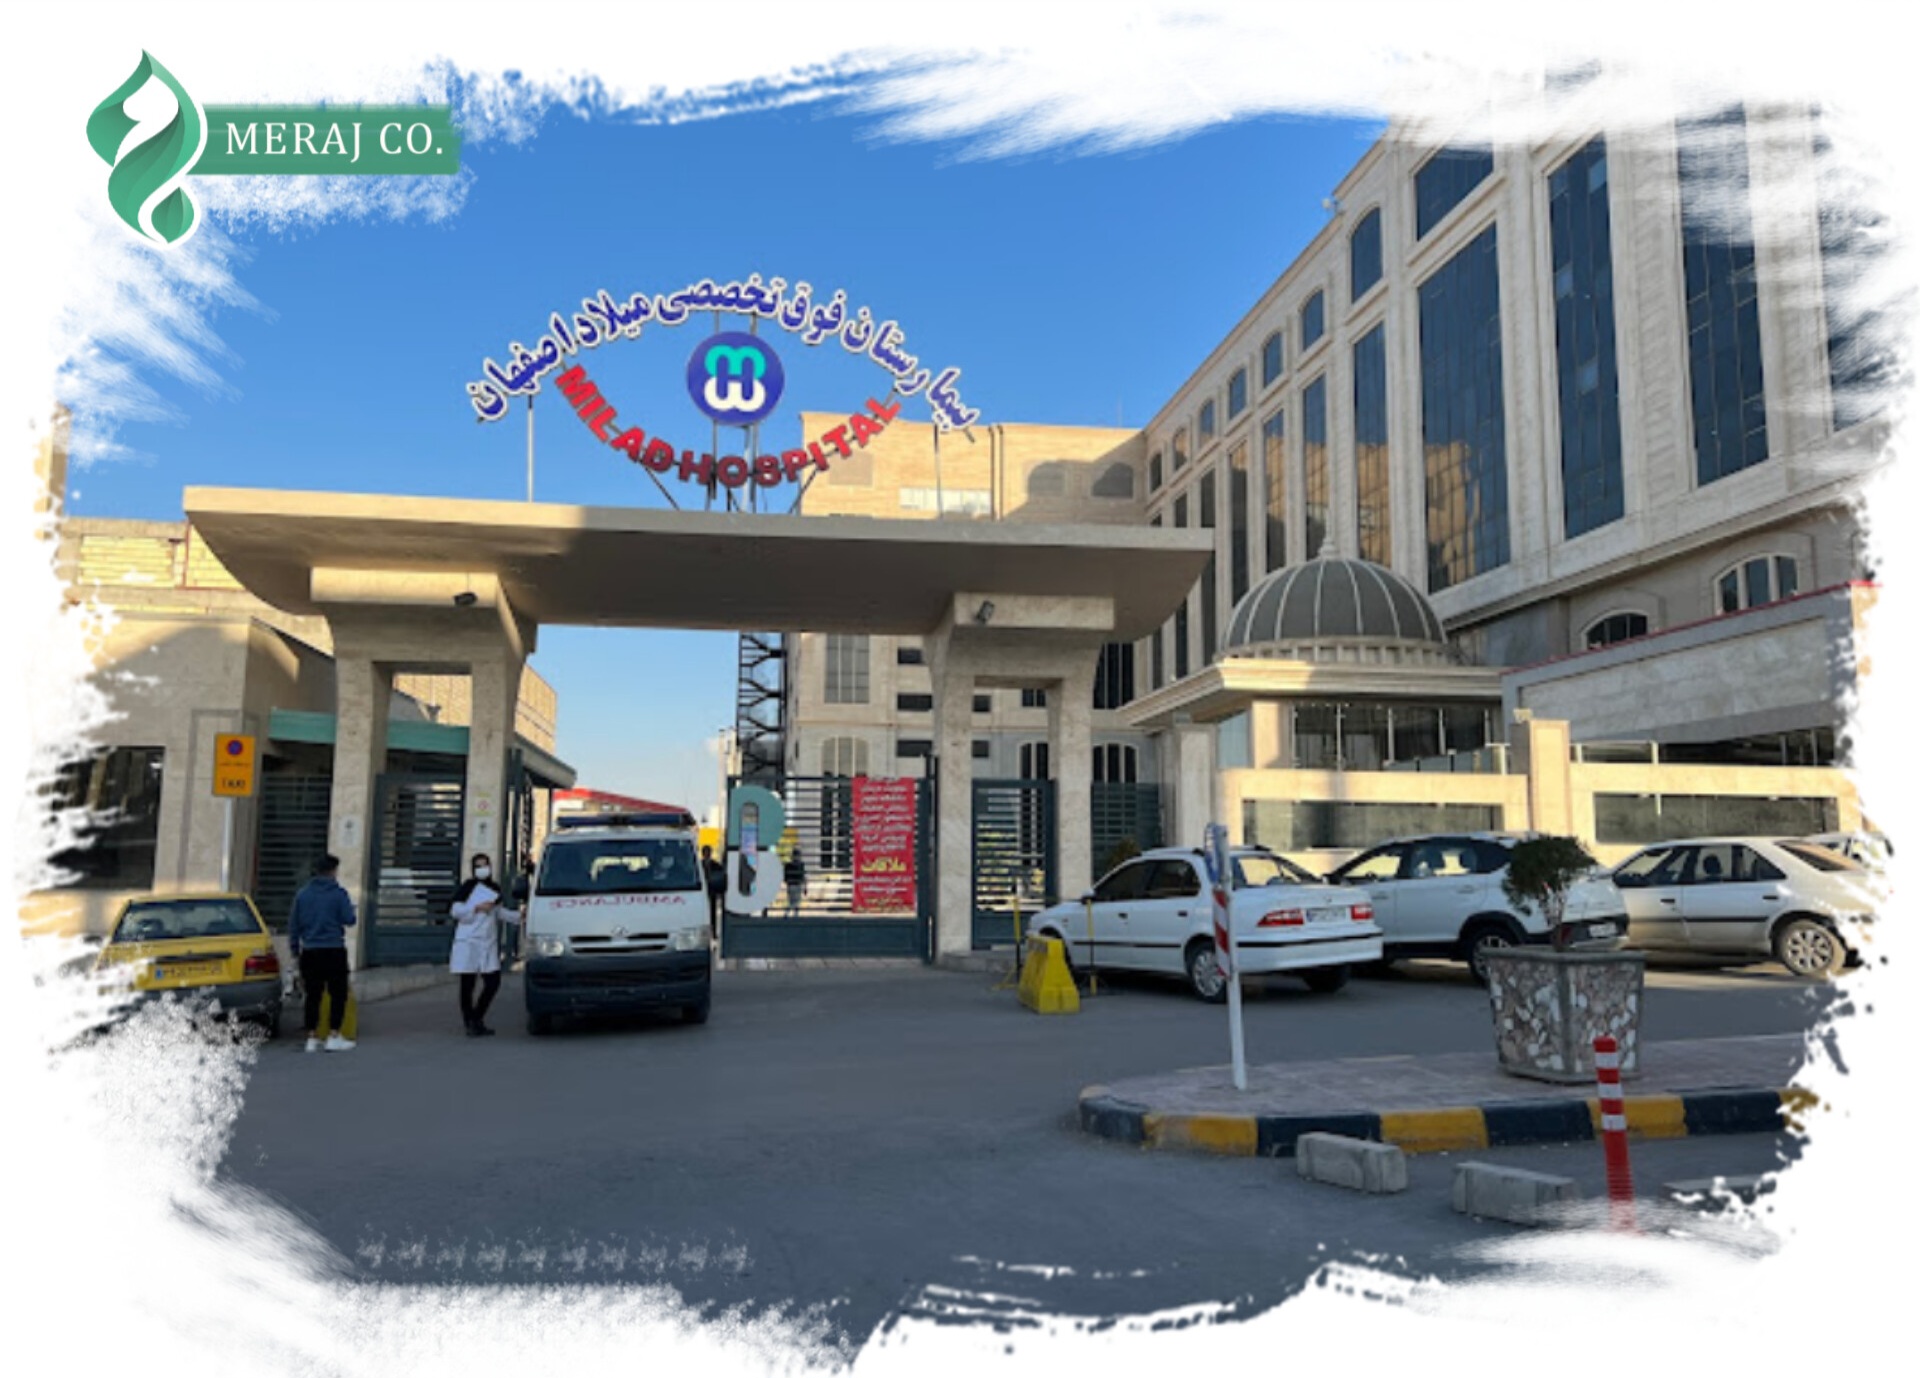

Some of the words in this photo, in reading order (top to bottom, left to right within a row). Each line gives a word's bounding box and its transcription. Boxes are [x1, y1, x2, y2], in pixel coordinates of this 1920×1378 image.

[572, 288, 653, 348] میلاد
[655, 273, 787, 327] تخصصی
[778, 278, 847, 345] فوق
[466, 311, 578, 421] اصفهان
[842, 305, 980, 433] بیمارستان
[555, 363, 675, 474] MILAD
[678, 396, 902, 489] HOSPITAL
